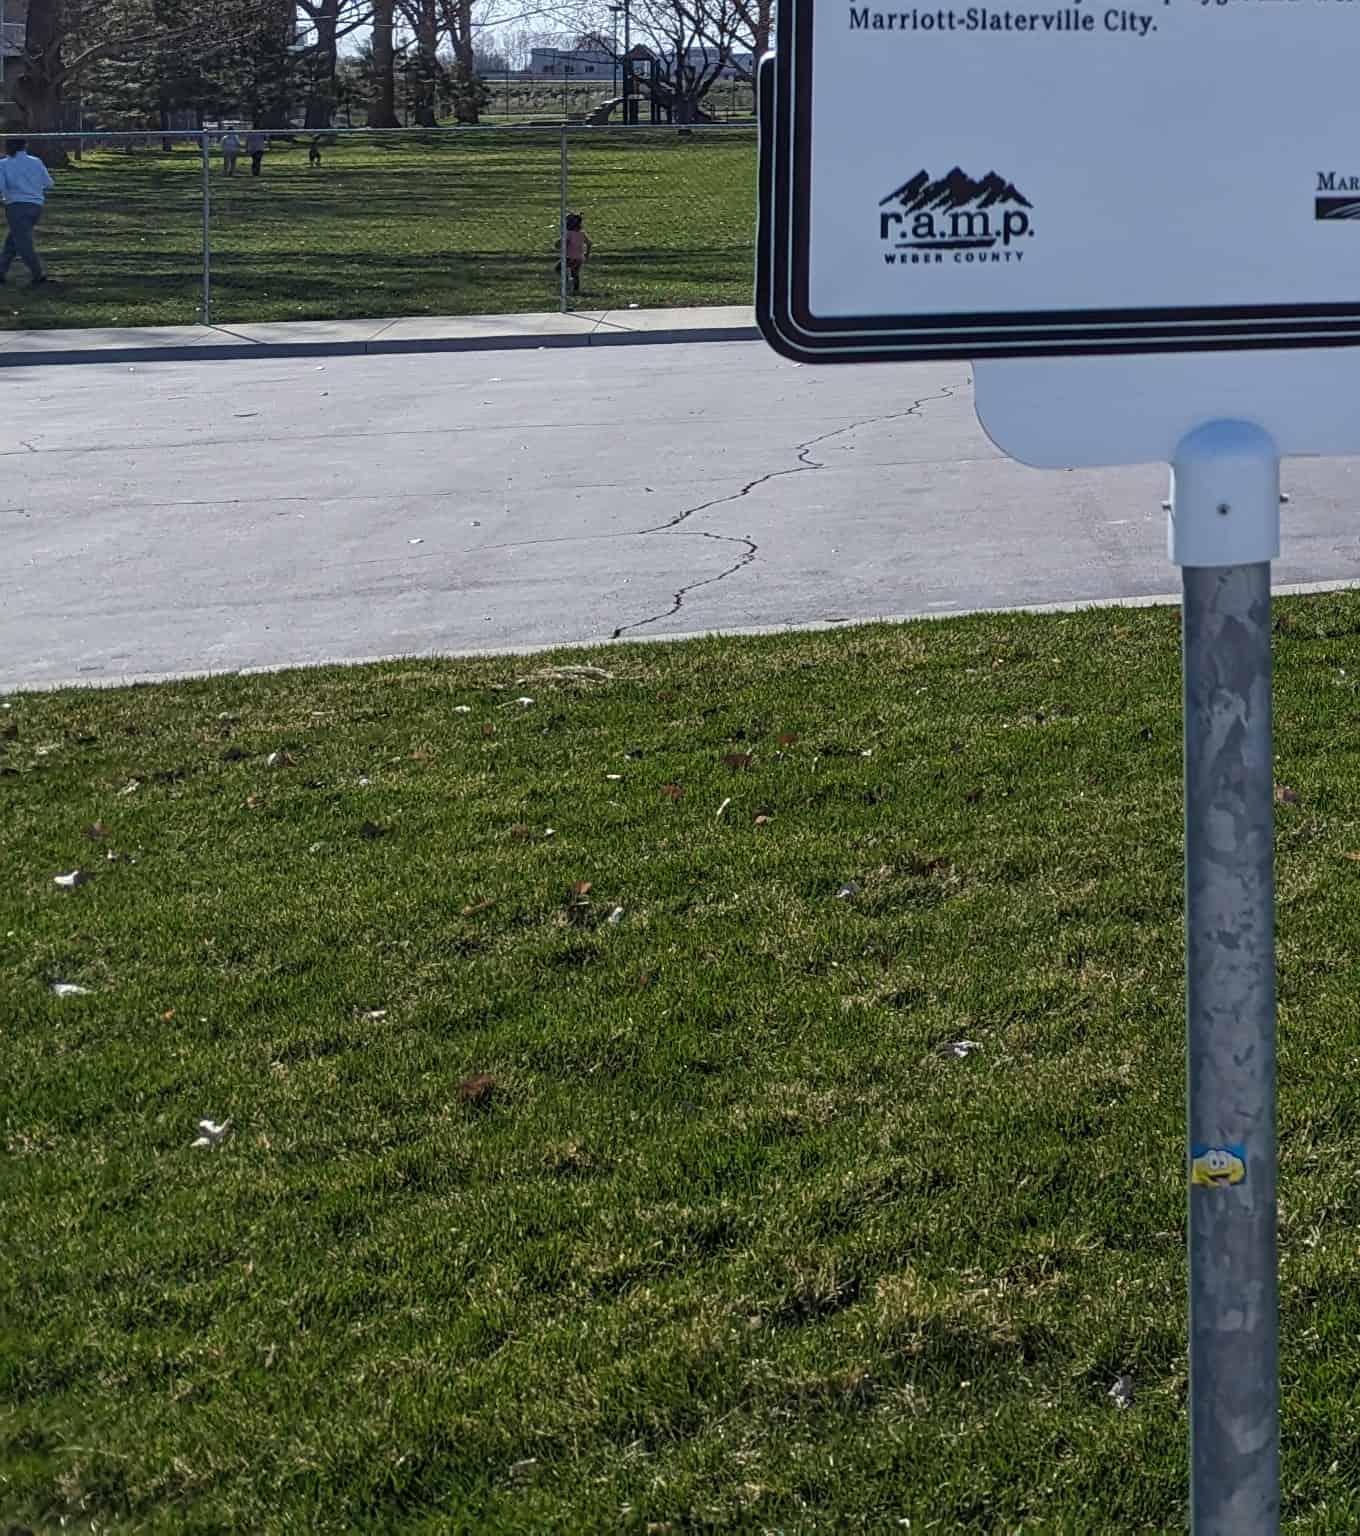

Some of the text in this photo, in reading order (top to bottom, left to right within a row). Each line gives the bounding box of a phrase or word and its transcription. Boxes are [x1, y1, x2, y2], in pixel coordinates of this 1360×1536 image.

[849, 7, 1158, 37] Marriott-Slaterville City.
[879, 210, 1035, 247] r.a.m.p.
[884, 250, 1024, 265] WEBER COUNTY
